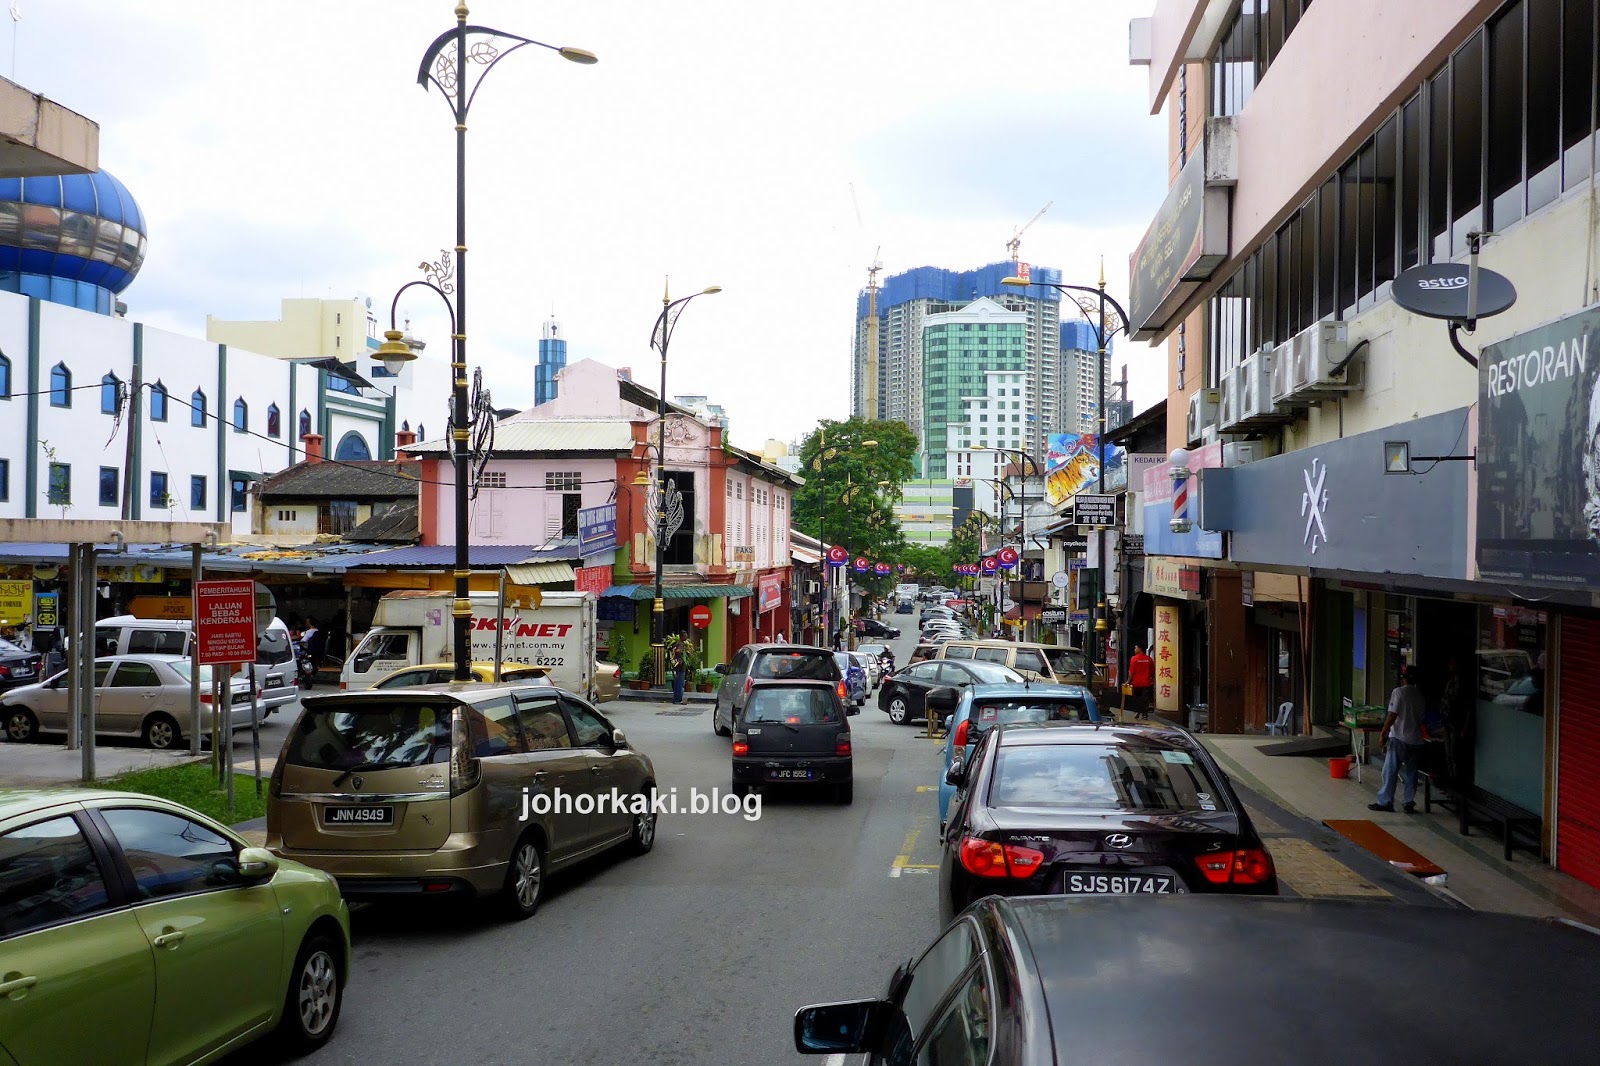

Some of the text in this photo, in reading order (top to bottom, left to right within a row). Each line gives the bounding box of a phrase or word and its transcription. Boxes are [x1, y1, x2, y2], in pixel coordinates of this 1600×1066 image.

[1418, 276, 1468, 290] astro
[1487, 333, 1588, 399] RESTORAN
[736, 546, 753, 554] FAKS
[200, 586, 251, 595] PEMBERITAHUAN
[209, 602, 242, 610] LALUAN
[211, 609, 240, 617] BEBAS
[200, 616, 252, 625] KENDERAAN
[470, 618, 573, 637] SKYNET
[536, 657, 564, 666] 6222
[984, 706, 996, 719] P
[778, 770, 807, 778] JFC 1552
[332, 809, 385, 821] JNN 4949
